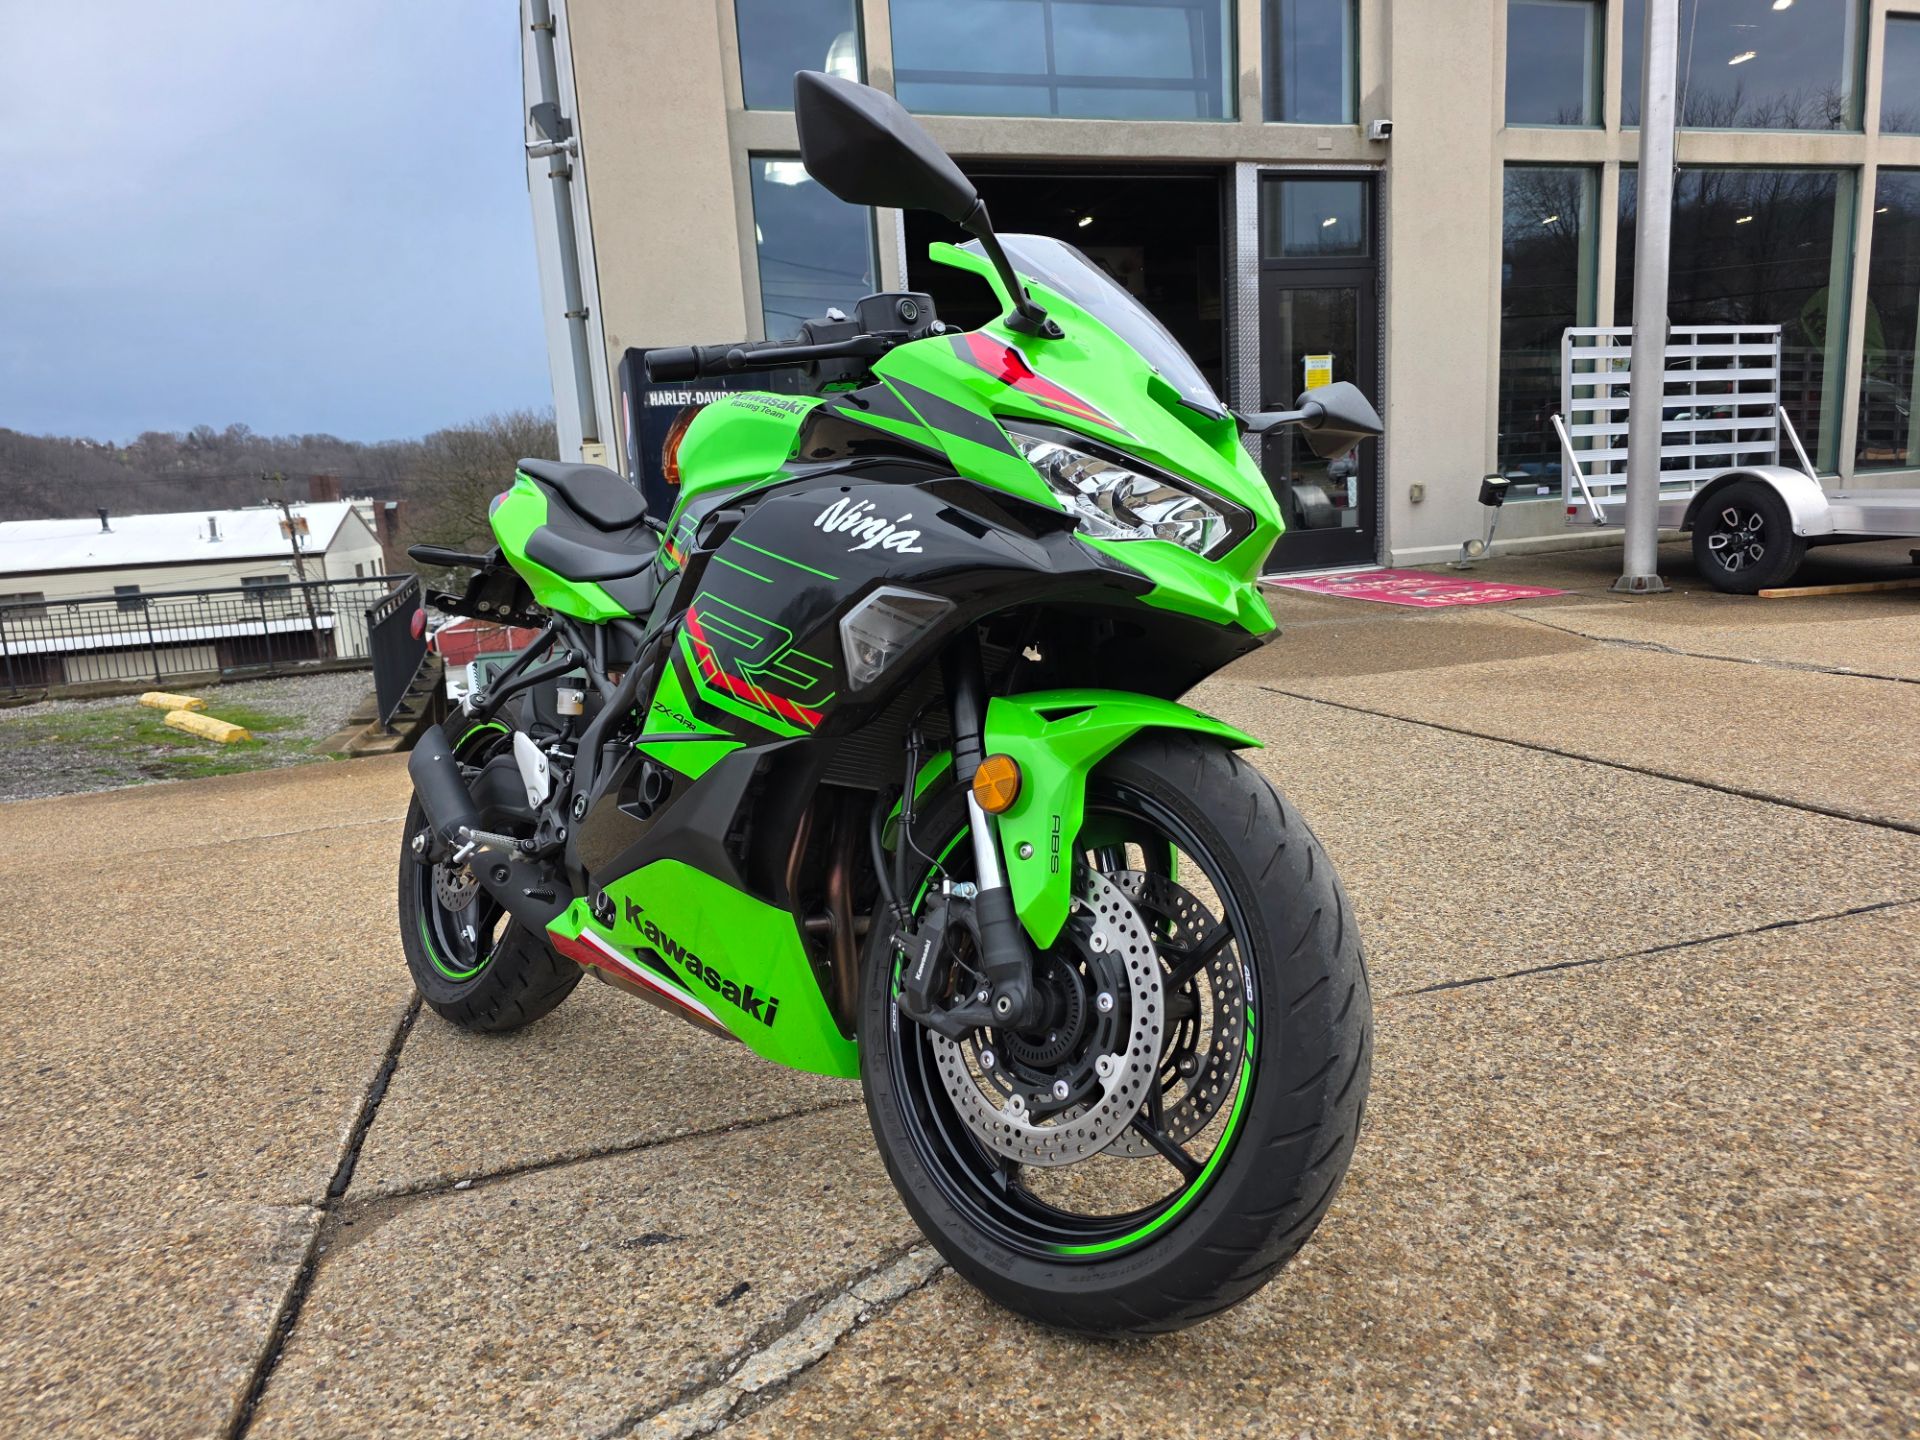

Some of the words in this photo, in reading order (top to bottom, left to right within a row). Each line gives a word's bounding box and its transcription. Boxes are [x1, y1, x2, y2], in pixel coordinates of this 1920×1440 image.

[649, 390, 741, 407] HARLEY-DAVID
[760, 405, 785, 419] Team
[814, 497, 923, 553] Ninja
[653, 701, 697, 732] ZX-4RR
[1050, 814, 1061, 875] ABS
[625, 895, 780, 1028] Kawasaki
[914, 939, 932, 981] Kawasaki
